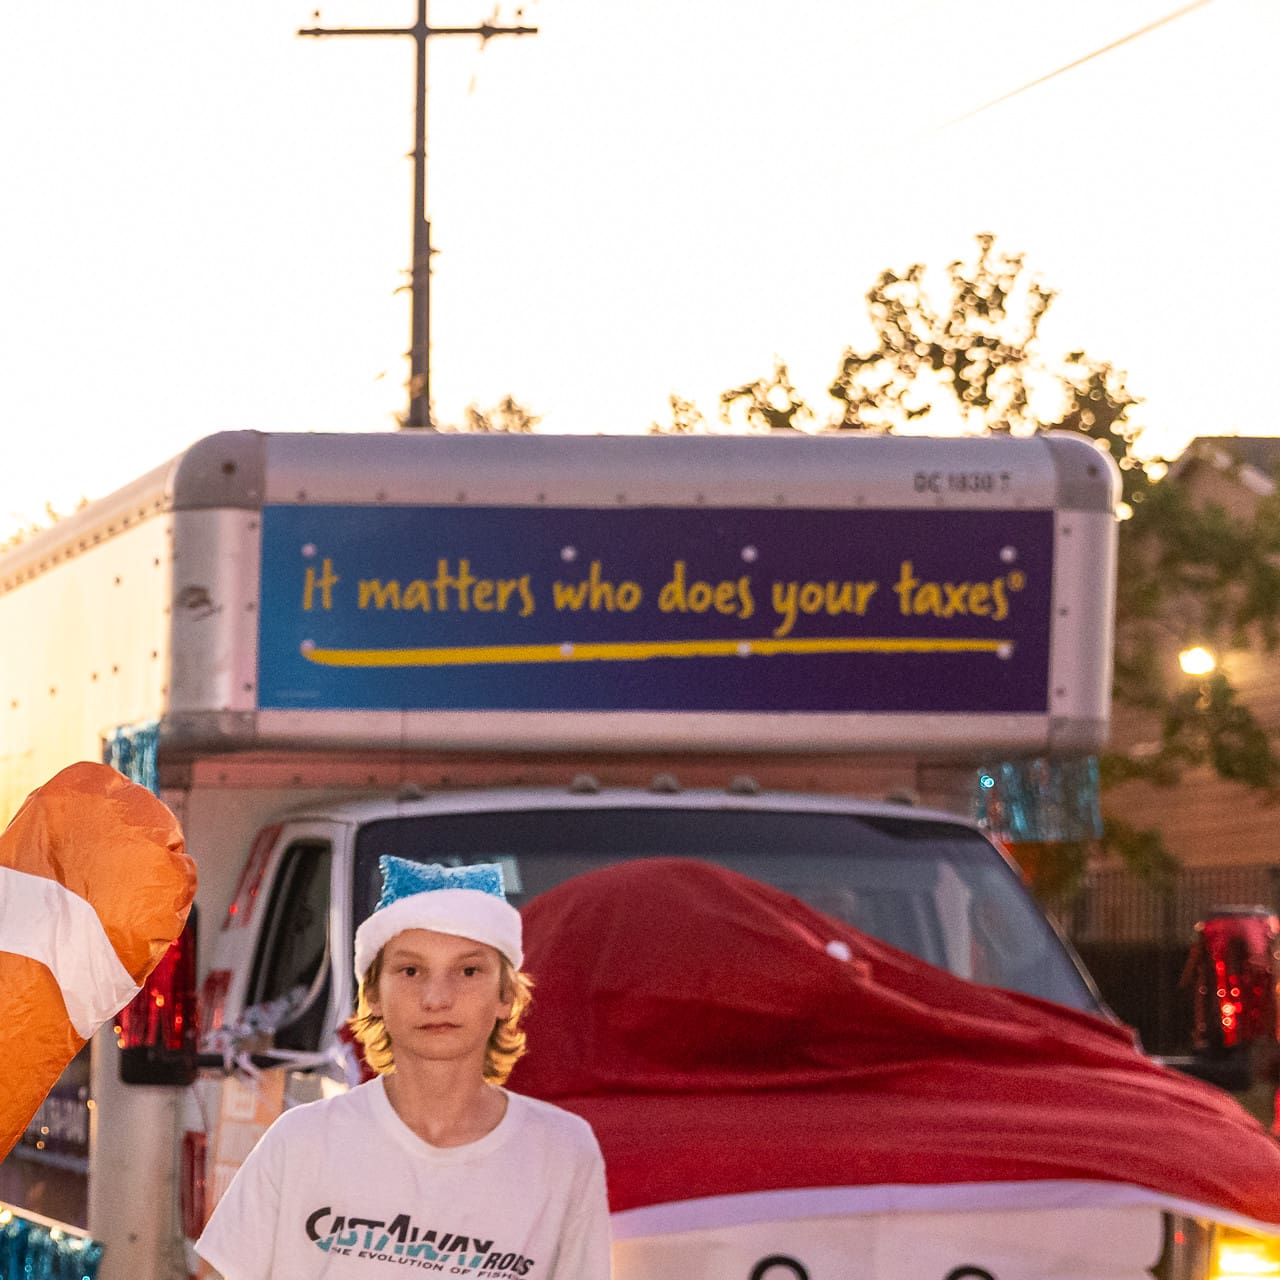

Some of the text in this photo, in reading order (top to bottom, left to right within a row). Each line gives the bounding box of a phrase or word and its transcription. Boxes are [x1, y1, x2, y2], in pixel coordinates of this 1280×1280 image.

[358, 559, 535, 617] matters
[553, 561, 641, 612] who
[658, 560, 755, 619] does
[771, 580, 878, 638] your
[358, 1250, 444, 1272] EVOLUTION
[450, 1266, 471, 1275] OF
